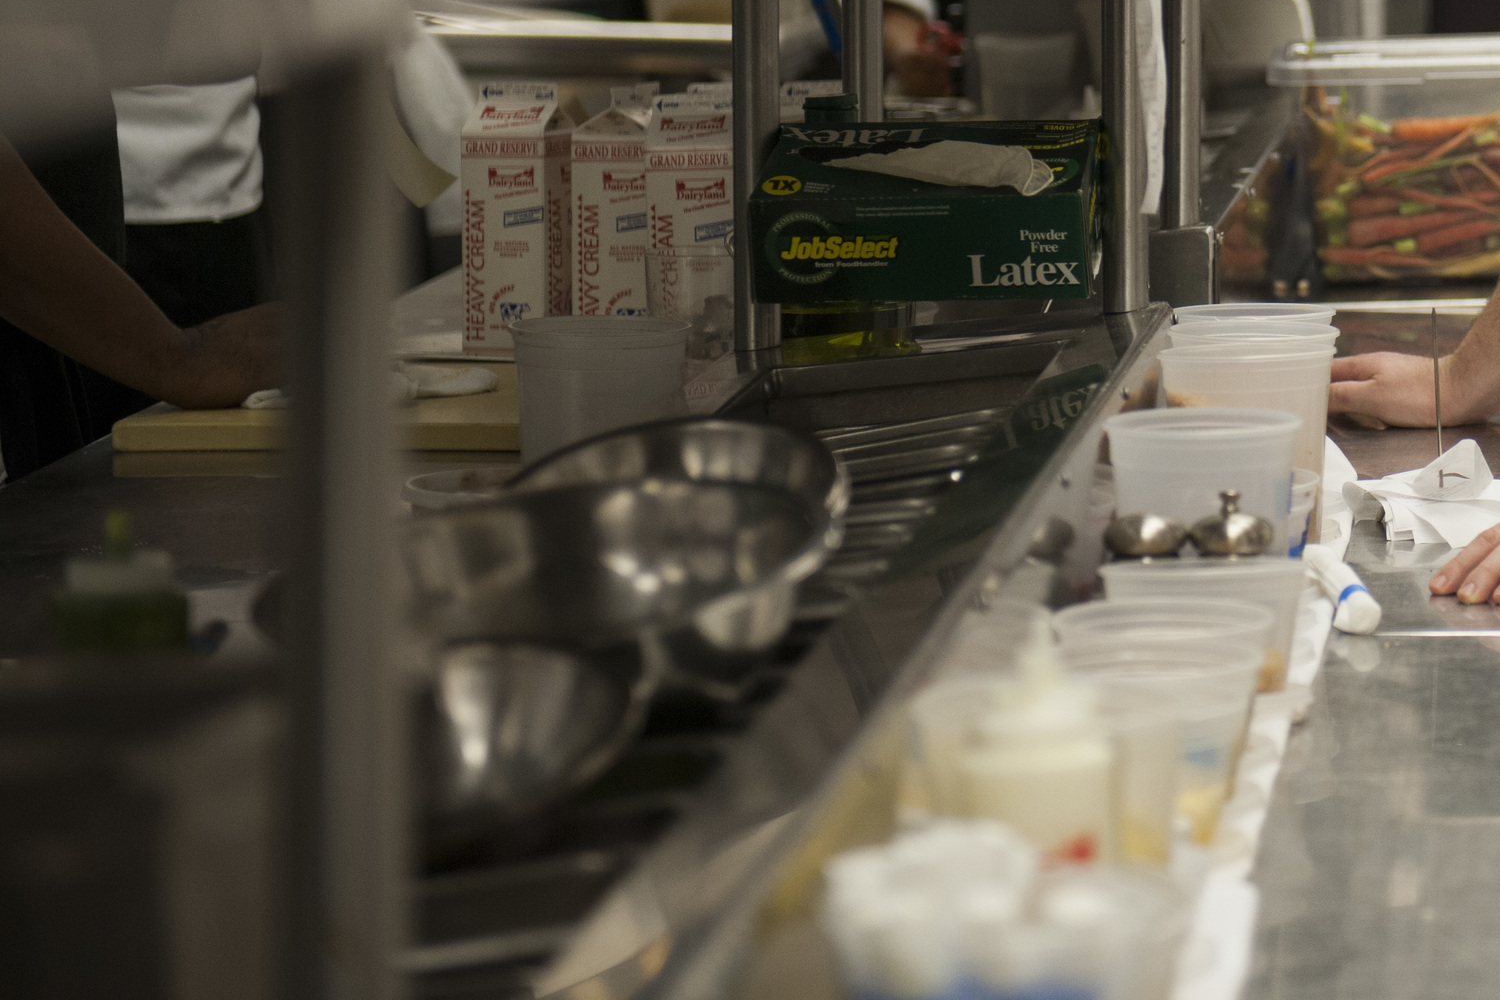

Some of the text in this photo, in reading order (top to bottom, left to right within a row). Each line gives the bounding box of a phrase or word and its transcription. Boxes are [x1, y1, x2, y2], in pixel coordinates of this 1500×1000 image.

[781, 125, 929, 148] Latex
[465, 141, 498, 155] GRAND
[499, 140, 539, 154] RESERVE
[574, 145, 609, 158] GRAND
[611, 144, 645, 158] RESERV
[650, 153, 729, 168] GRAND RESERVE
[488, 175, 535, 189] Dairyland
[603, 180, 645, 193] Dairylan
[767, 179, 798, 191] XL
[676, 187, 726, 202] Dairyland
[771, 211, 832, 234] PROFESSIONAL
[1019, 229, 1068, 241] Powder
[780, 235, 899, 260] JobSelect
[1030, 242, 1059, 254] Free
[552, 198, 563, 315] AVY CREAM
[584, 203, 599, 316] AVY CREAM
[836, 260, 889, 268] FoodHandler
[471, 199, 485, 341] HEAVY CREAM
[777, 267, 834, 285] PROTECTION
[965, 254, 1081, 288] Latex
